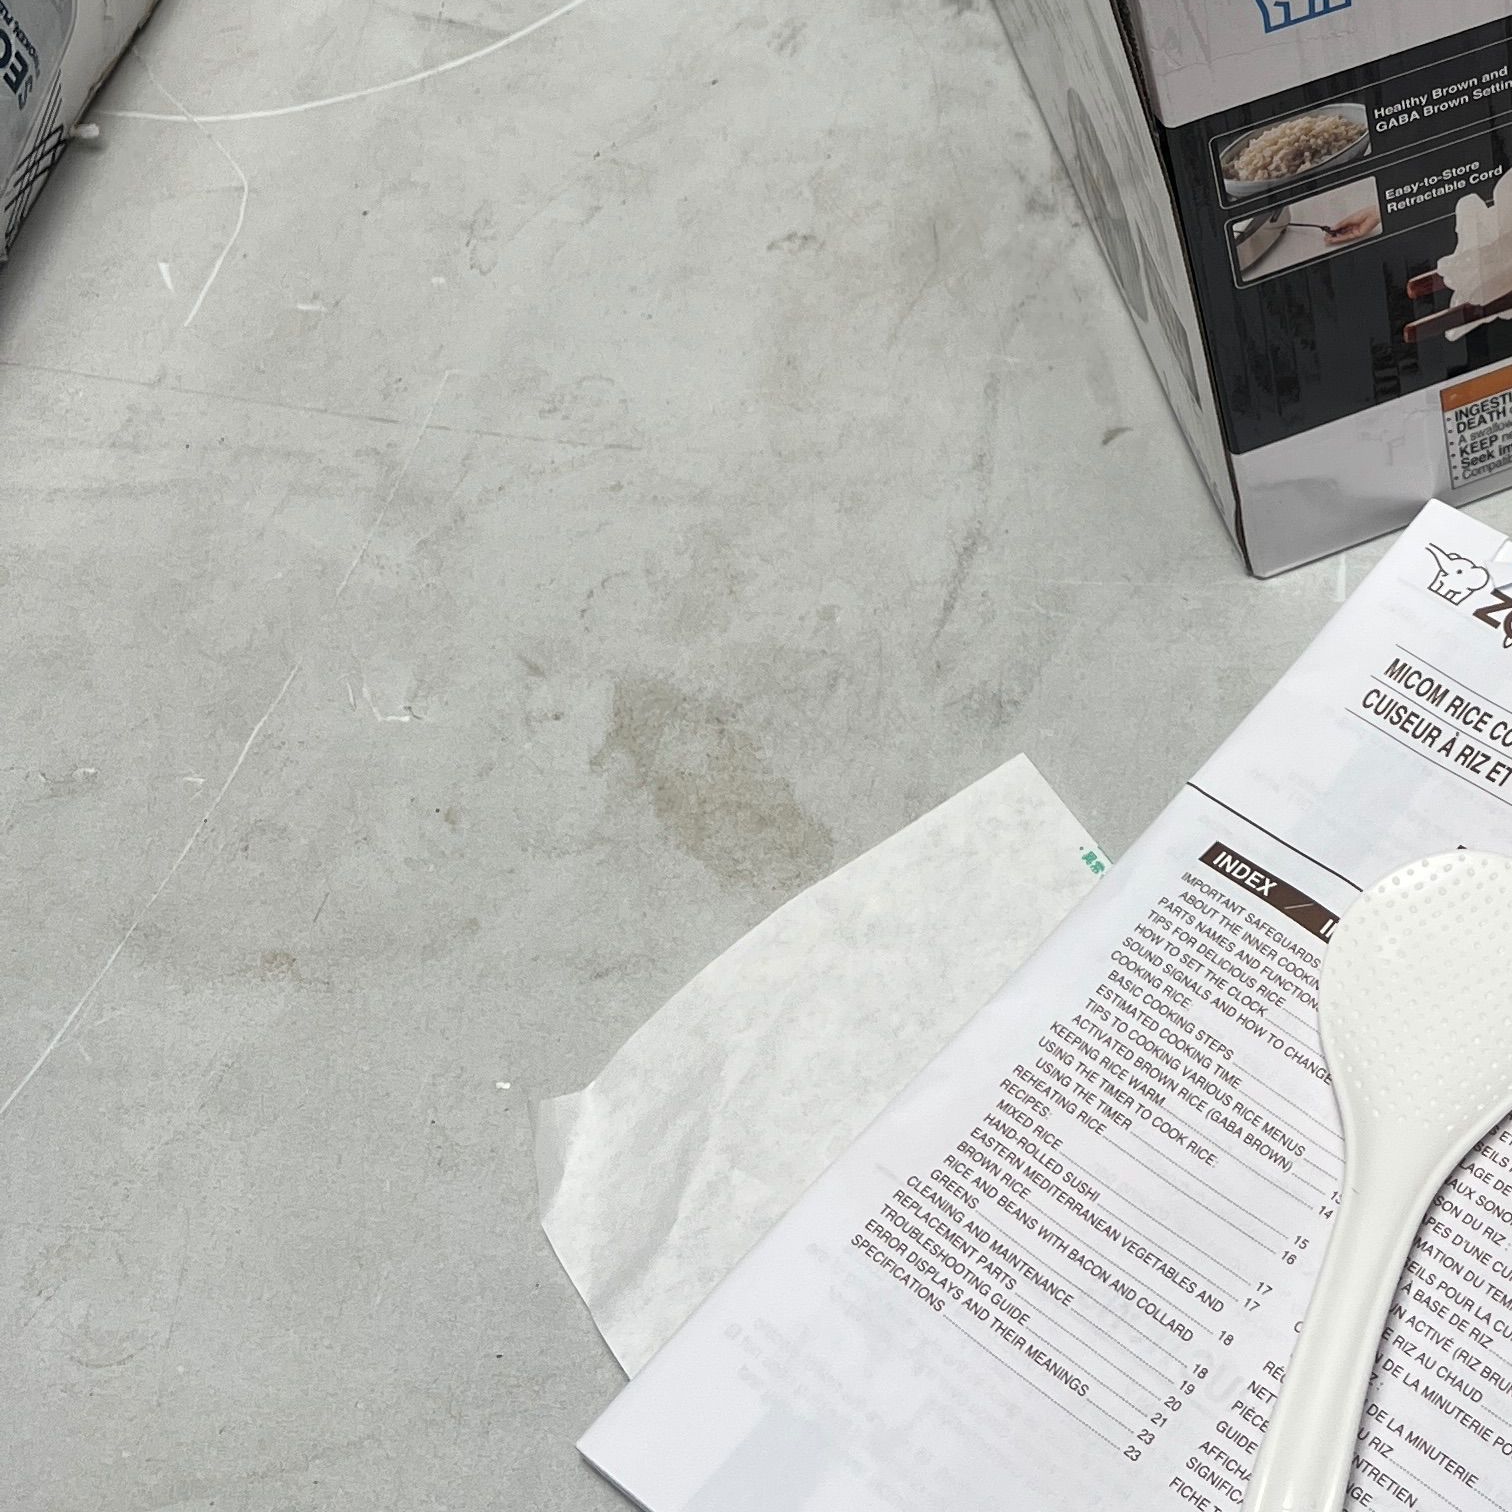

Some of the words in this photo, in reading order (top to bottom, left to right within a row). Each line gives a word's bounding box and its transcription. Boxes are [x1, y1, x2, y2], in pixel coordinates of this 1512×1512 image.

[1374, 94, 1428, 119] Healthy
[1432, 77, 1478, 100] Brown
[1481, 65, 1508, 83] and
[1375, 110, 1420, 132] GABA
[1423, 95, 1469, 117] Brown
[1385, 161, 1480, 200] Easy-to-Store
[1387, 180, 1466, 213] Retractable
[1471, 163, 1504, 184] Cord
[1362, 688, 1446, 748] CUISEUR
[1436, 731, 1460, 758] À
[1454, 744, 1492, 775] RIZ
[1384, 658, 1450, 707] MICOM
[1444, 695, 1494, 733] RICE
[1213, 851, 1277, 896] INDEX
[1133, 922, 1166, 946] HOW
[1163, 940, 1181, 957] TO
[1179, 953, 1206, 973] SET
[1204, 968, 1229, 991] THE
[1227, 986, 1269, 1018] CLOCK
[1147, 909, 1173, 931] TIPS
[1171, 926, 1198, 948] FOR
[1196, 943, 1258, 989] DELICIOUS
[1255, 984, 1287, 1008] RICE
[1049, 1020, 1100, 1061] KEEPING
[1098, 1055, 1130, 1081] RICE
[1128, 1075, 1166, 1107] WARM
[1318, 1205, 1334, 1220] 14
[983, 1113, 1064, 1175] HAND-ROLLED
[1062, 1171, 1101, 1202] SUSHI
[1243, 1297, 1261, 1312] 17
[906, 1175, 965, 1224] CLEANING
[962, 1220, 991, 1244] AND
[989, 1239, 1074, 1307] MAINTENANCE
[1179, 1380, 1196, 1396] 19
[850, 1234, 946, 1312] SPECIFICATIONS
[1123, 1445, 1142, 1462] 23
